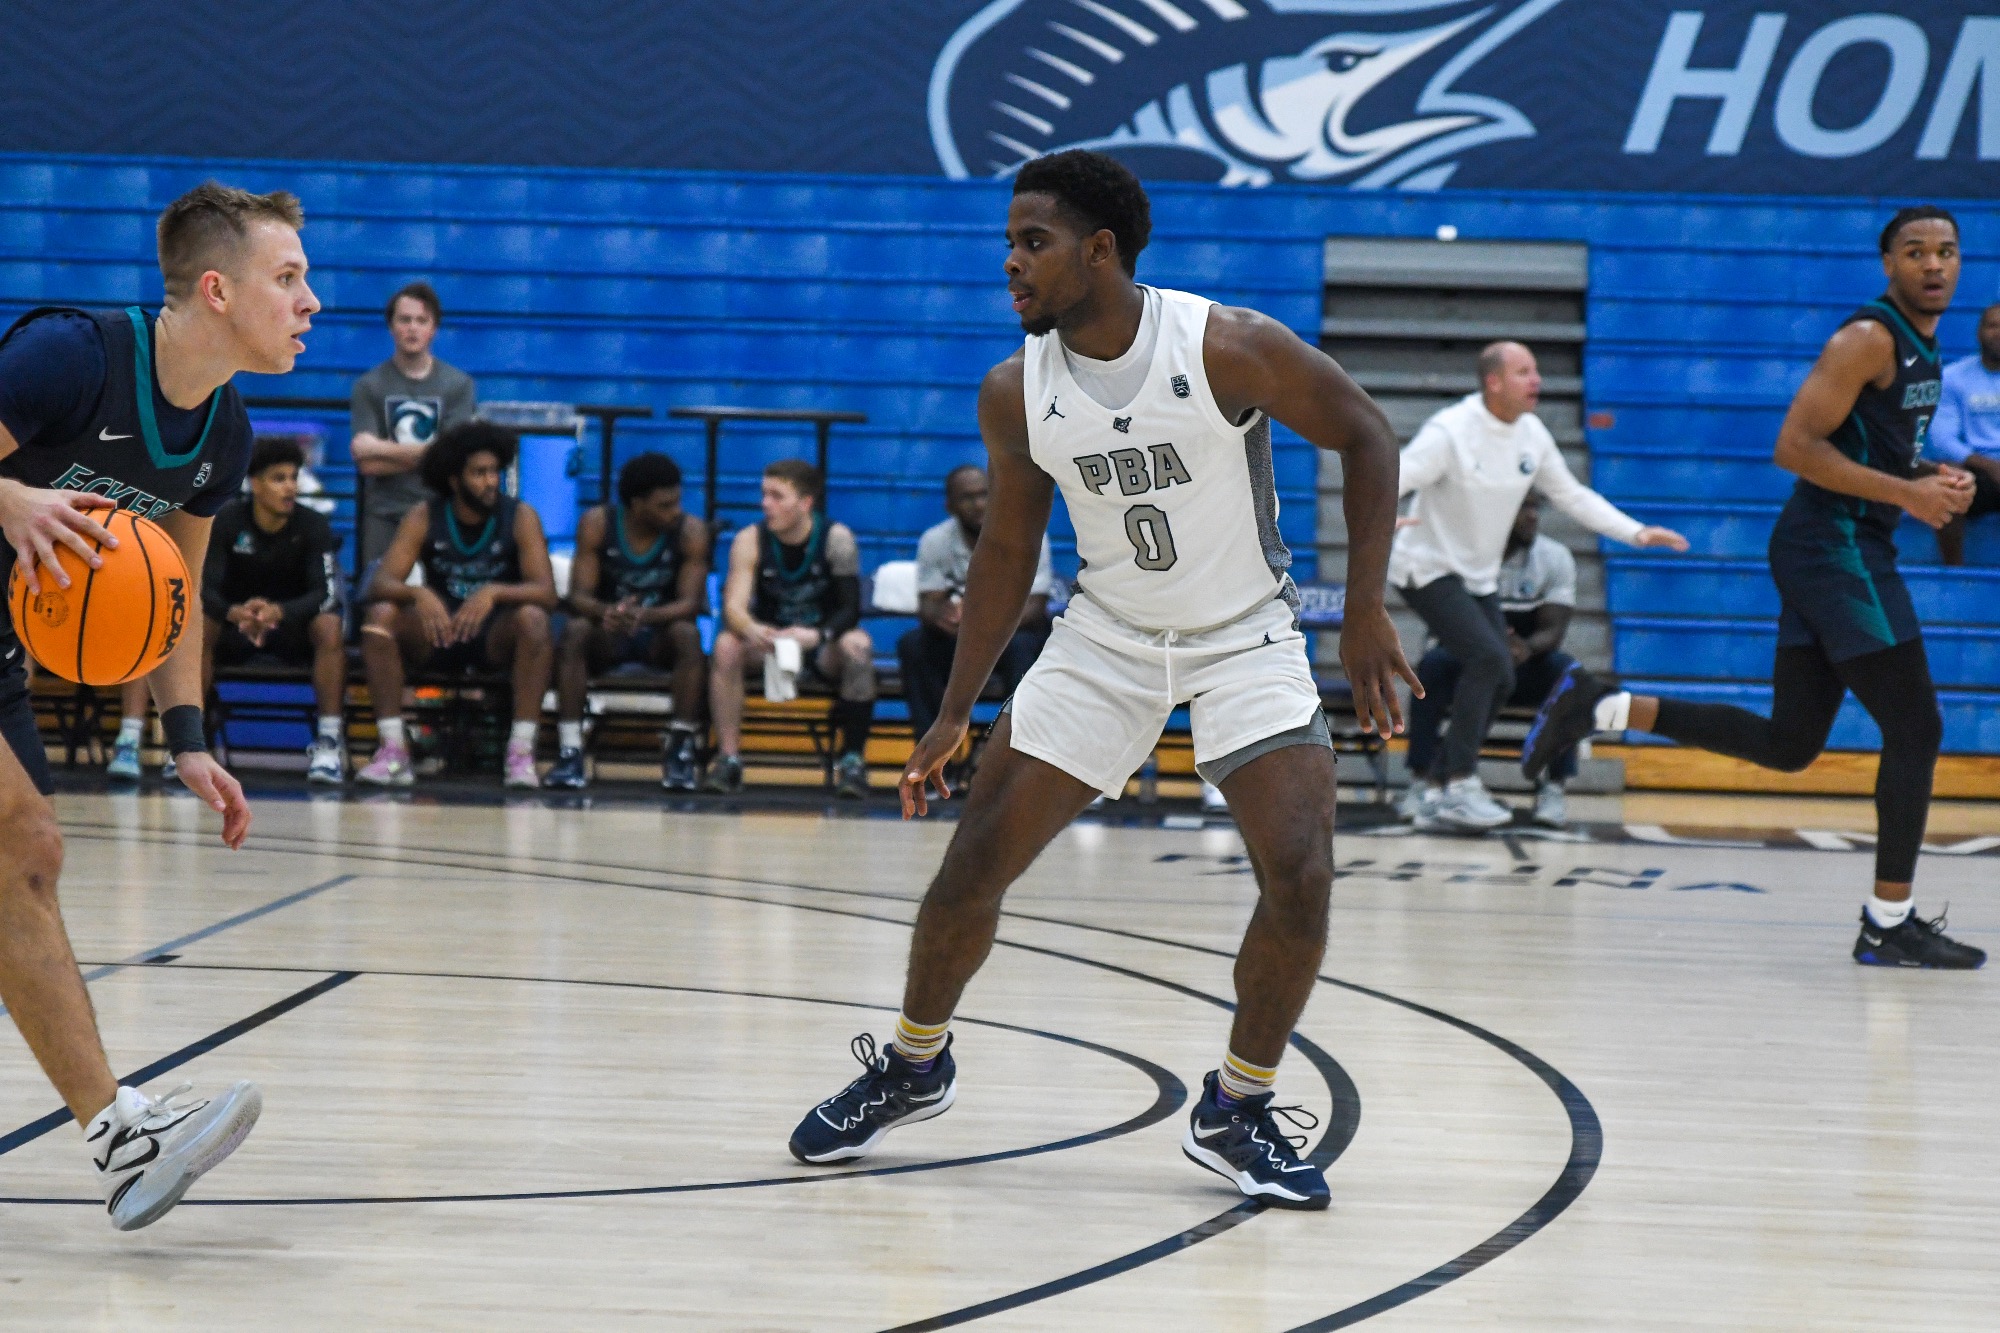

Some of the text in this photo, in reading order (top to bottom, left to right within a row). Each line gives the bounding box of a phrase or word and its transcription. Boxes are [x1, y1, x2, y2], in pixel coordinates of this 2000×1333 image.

[1073, 442, 1192, 496] PBA
[1124, 504, 1178, 571] 0
[157, 578, 185, 658] NCAA
